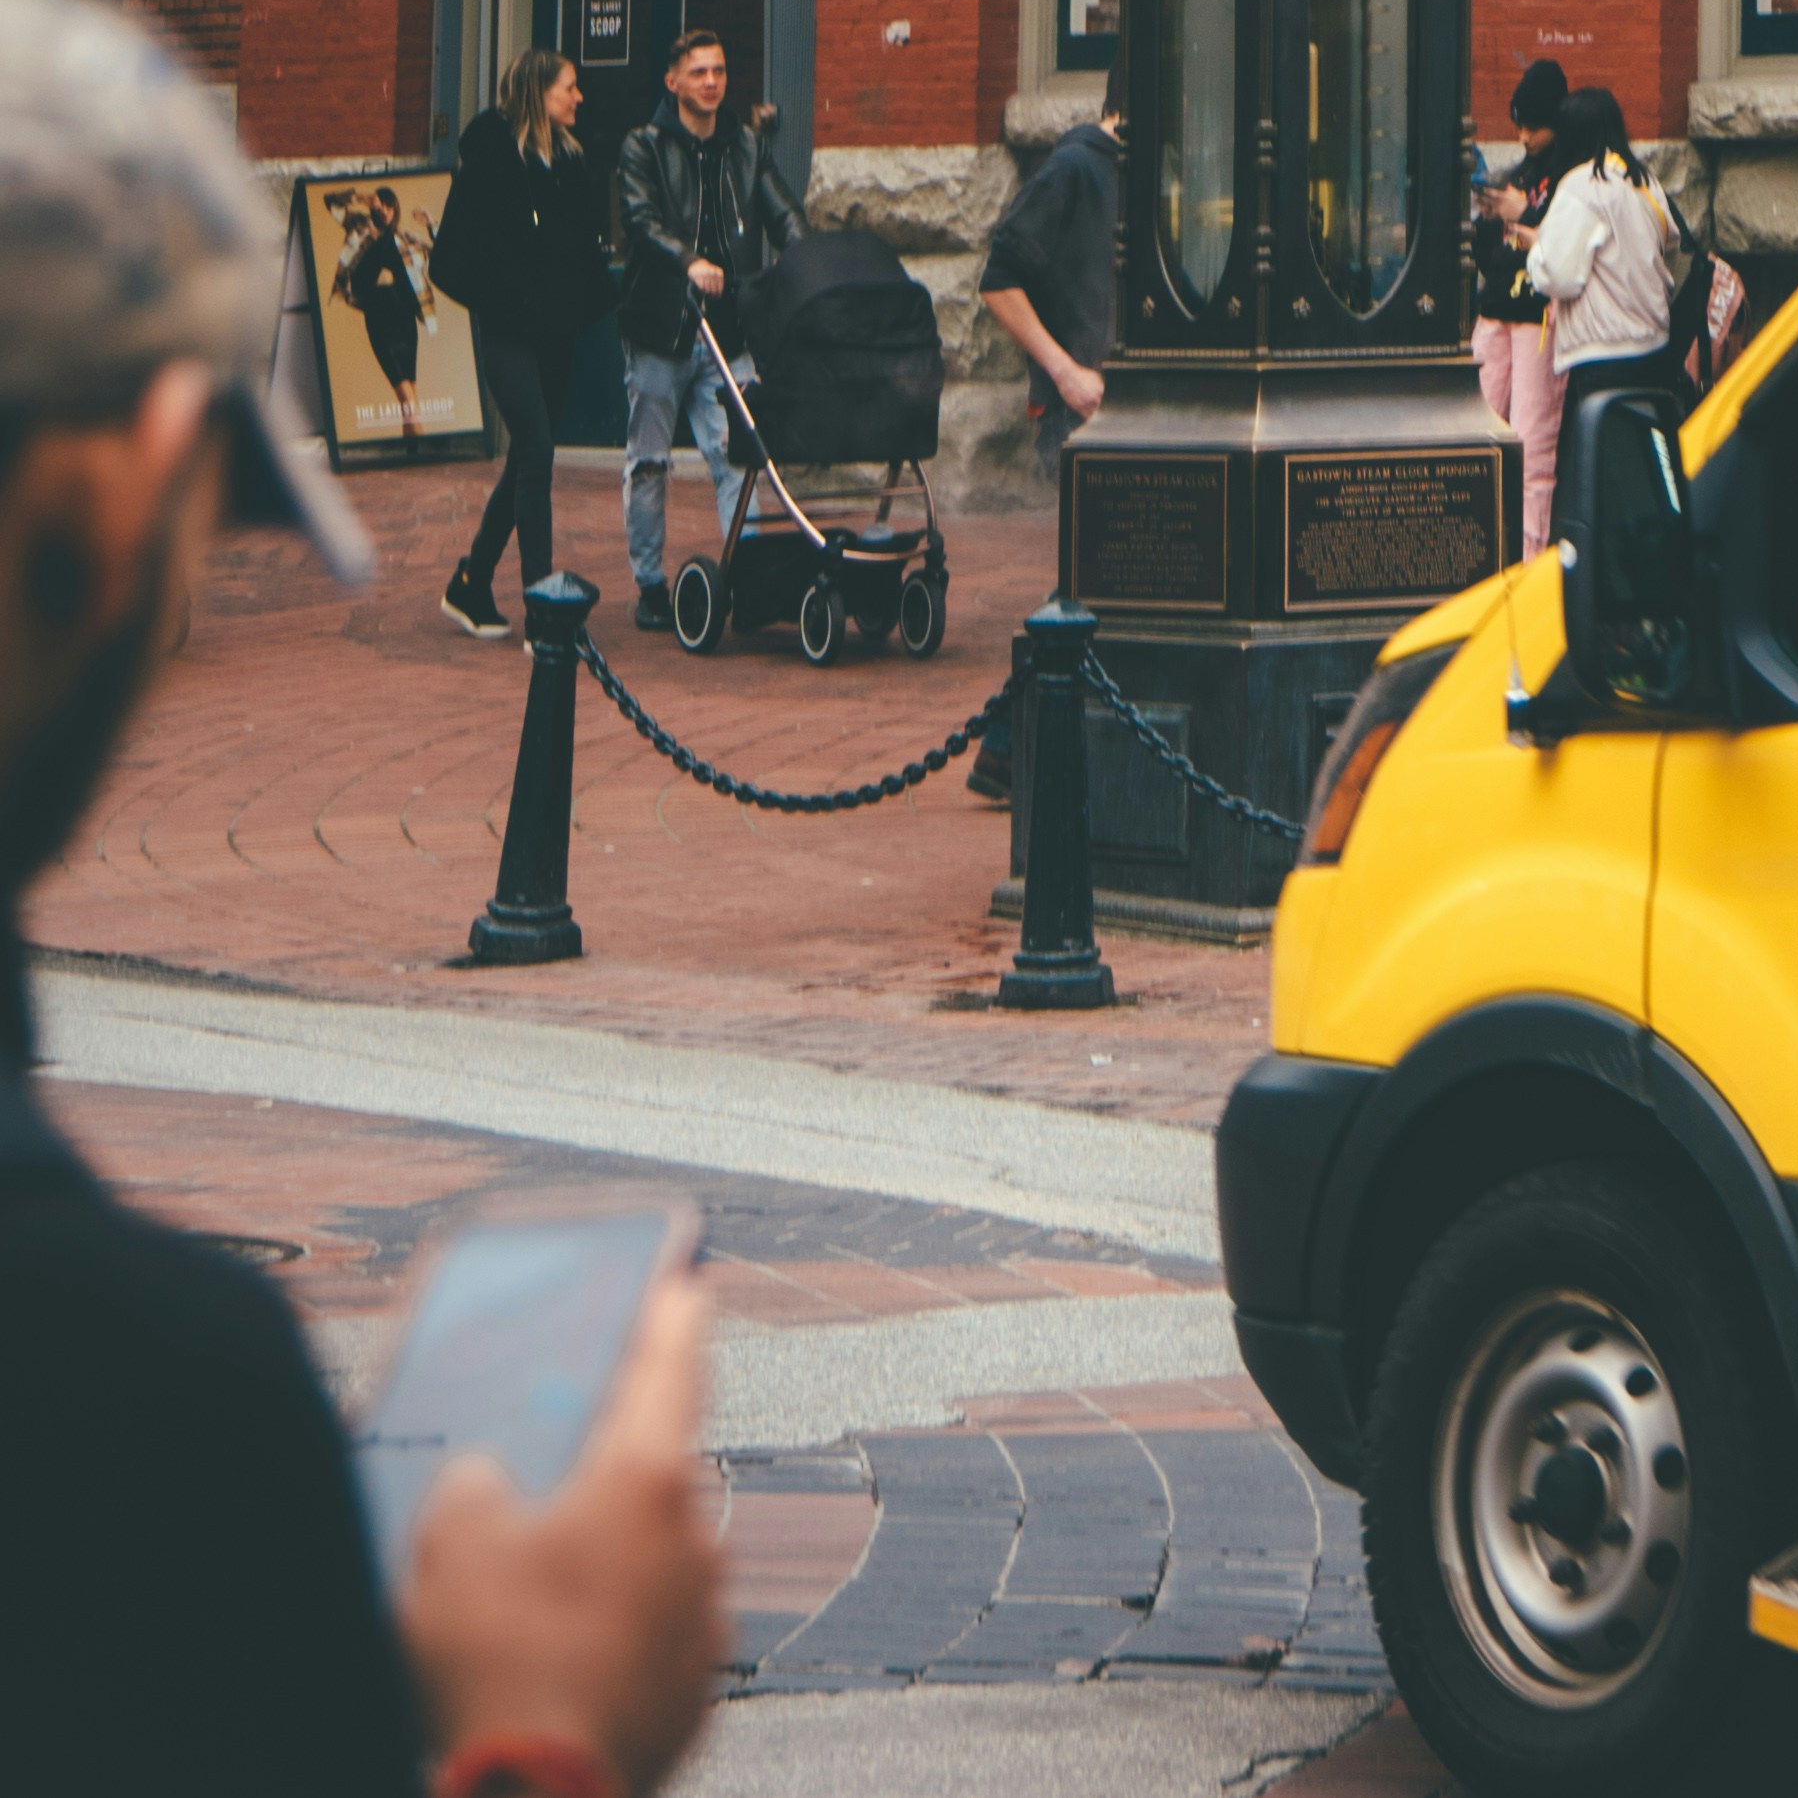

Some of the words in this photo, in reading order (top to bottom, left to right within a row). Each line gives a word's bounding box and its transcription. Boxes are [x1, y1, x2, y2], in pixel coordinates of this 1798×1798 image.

[590, 16, 622, 37] SCOOP
[355, 404, 374, 421] THE
[379, 400, 415, 420] LATEST
[419, 397, 454, 414] SCOOP
[1296, 467, 1352, 483] GASTOWN
[1356, 465, 1391, 481] STEAM
[1395, 464, 1430, 480] CLOCK
[1435, 462, 1489, 478] SPONSORS
